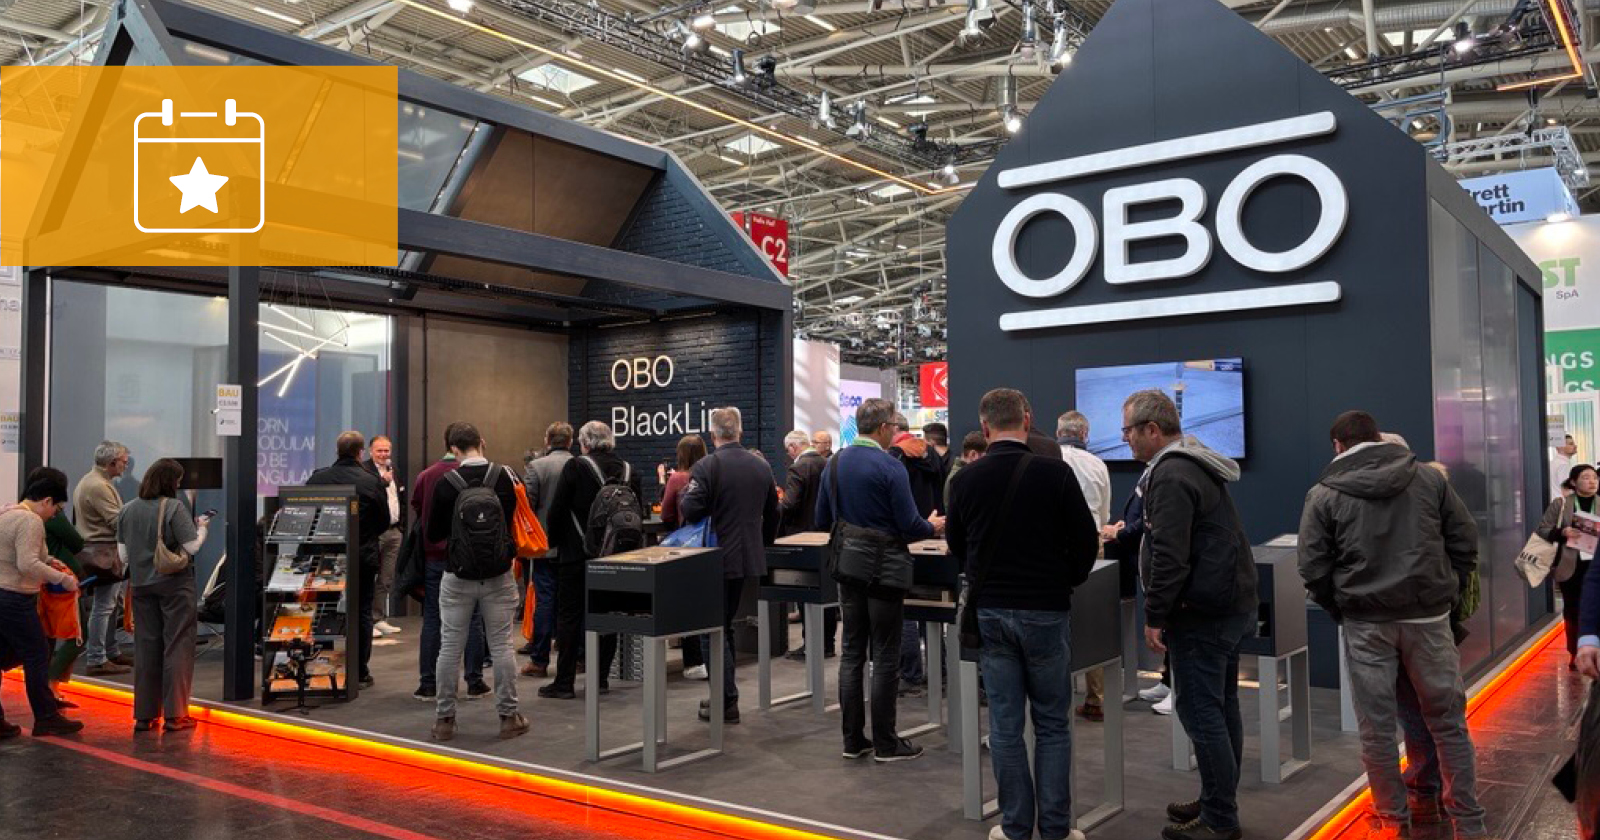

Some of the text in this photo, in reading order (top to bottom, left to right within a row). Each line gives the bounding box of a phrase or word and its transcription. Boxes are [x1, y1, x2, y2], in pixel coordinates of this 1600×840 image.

[992, 153, 1349, 298] OBO
[761, 235, 787, 262] C2
[1555, 289, 1579, 300] SpA
[611, 354, 674, 391] OBO
[218, 388, 239, 397] BAU
[257, 435, 316, 451] ODULA
[269, 452, 288, 468] BE
